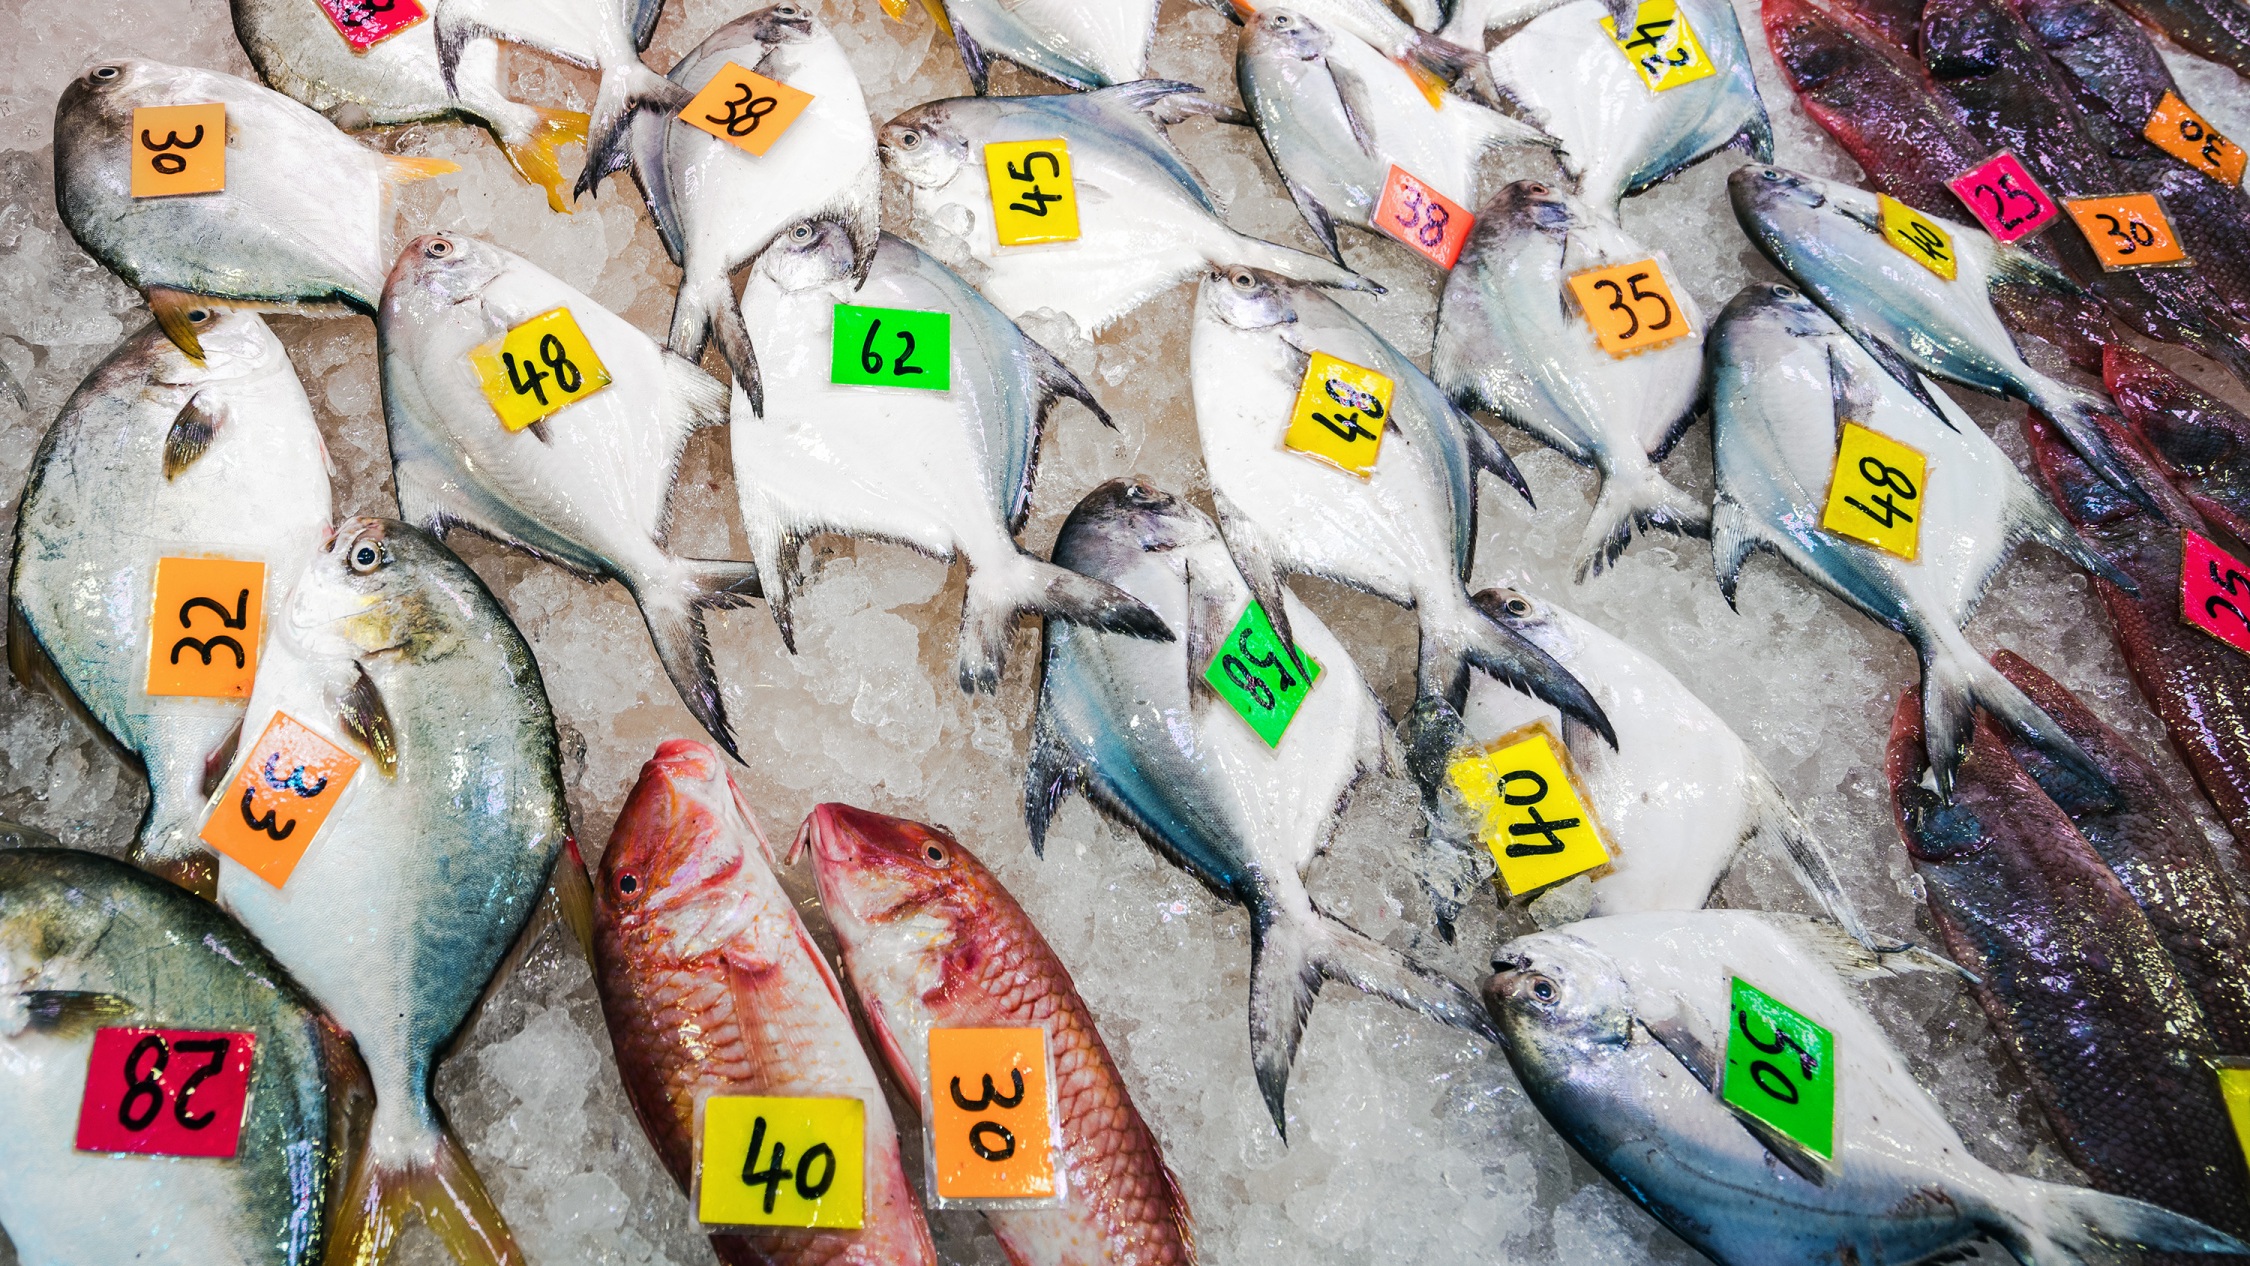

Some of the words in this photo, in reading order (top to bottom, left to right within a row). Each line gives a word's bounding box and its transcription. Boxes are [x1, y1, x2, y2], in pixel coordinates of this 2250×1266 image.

[1626, 19, 1689, 77] 42
[705, 82, 778, 137] 38
[141, 124, 205, 175] 30
[2180, 120, 2225, 167] 30
[1010, 151, 1062, 216] 45
[1395, 183, 1449, 247] 38
[1975, 172, 2040, 231] 25
[1897, 221, 1949, 261] 40
[2095, 213, 2153, 254] 30
[1594, 272, 1671, 339] 35
[502, 333, 582, 405] 48
[861, 319, 923, 374] 62
[1311, 378, 1384, 443] 48
[1844, 456, 1917, 528] 48
[171, 588, 249, 669] 32
[1222, 628, 1297, 710] 58
[241, 752, 327, 840] 33
[1496, 770, 1580, 859] 40
[118, 1035, 230, 1130] 28
[1739, 1010, 1819, 1105] 50
[950, 1067, 1024, 1163] 30
[741, 1116, 835, 1214] 40
